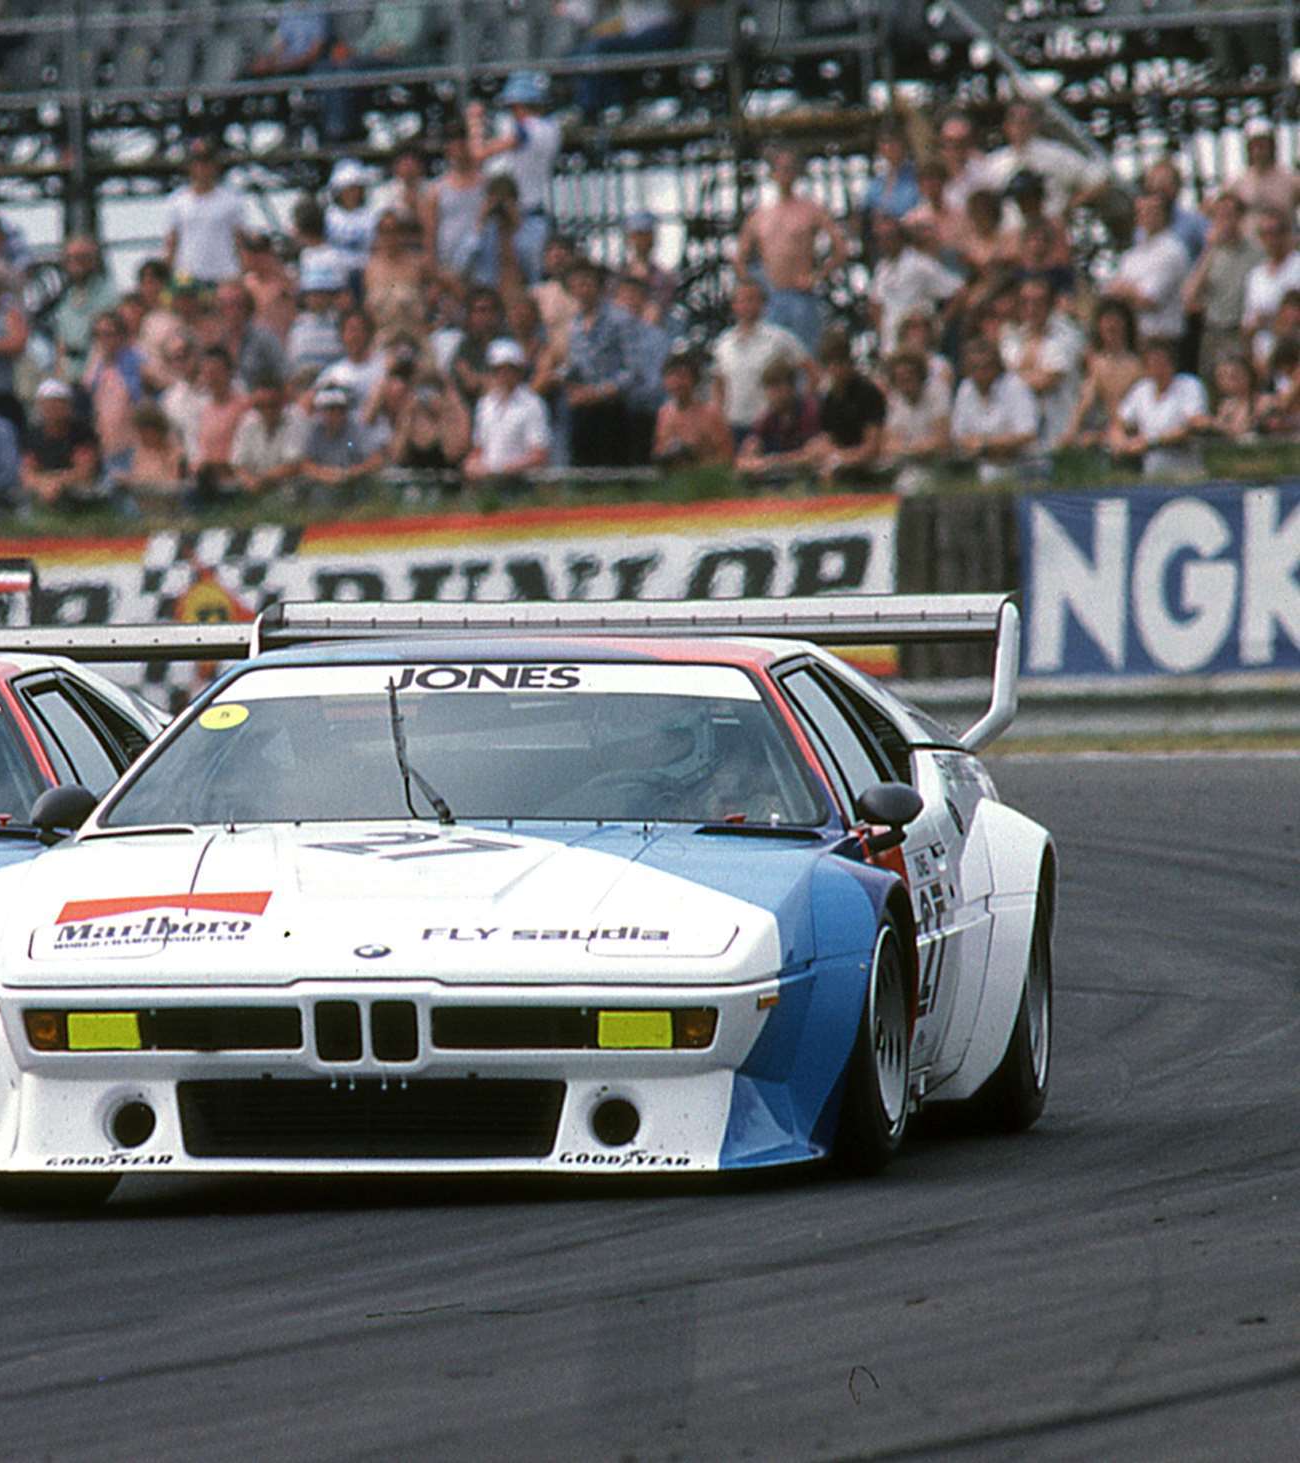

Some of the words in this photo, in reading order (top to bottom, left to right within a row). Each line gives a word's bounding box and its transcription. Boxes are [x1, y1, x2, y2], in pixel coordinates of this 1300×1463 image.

[1027, 487, 1300, 672] NGK
[388, 666, 580, 690] JONES
[57, 917, 252, 942] Marlboro
[422, 928, 499, 940] FLY
[512, 926, 669, 941] saudia
